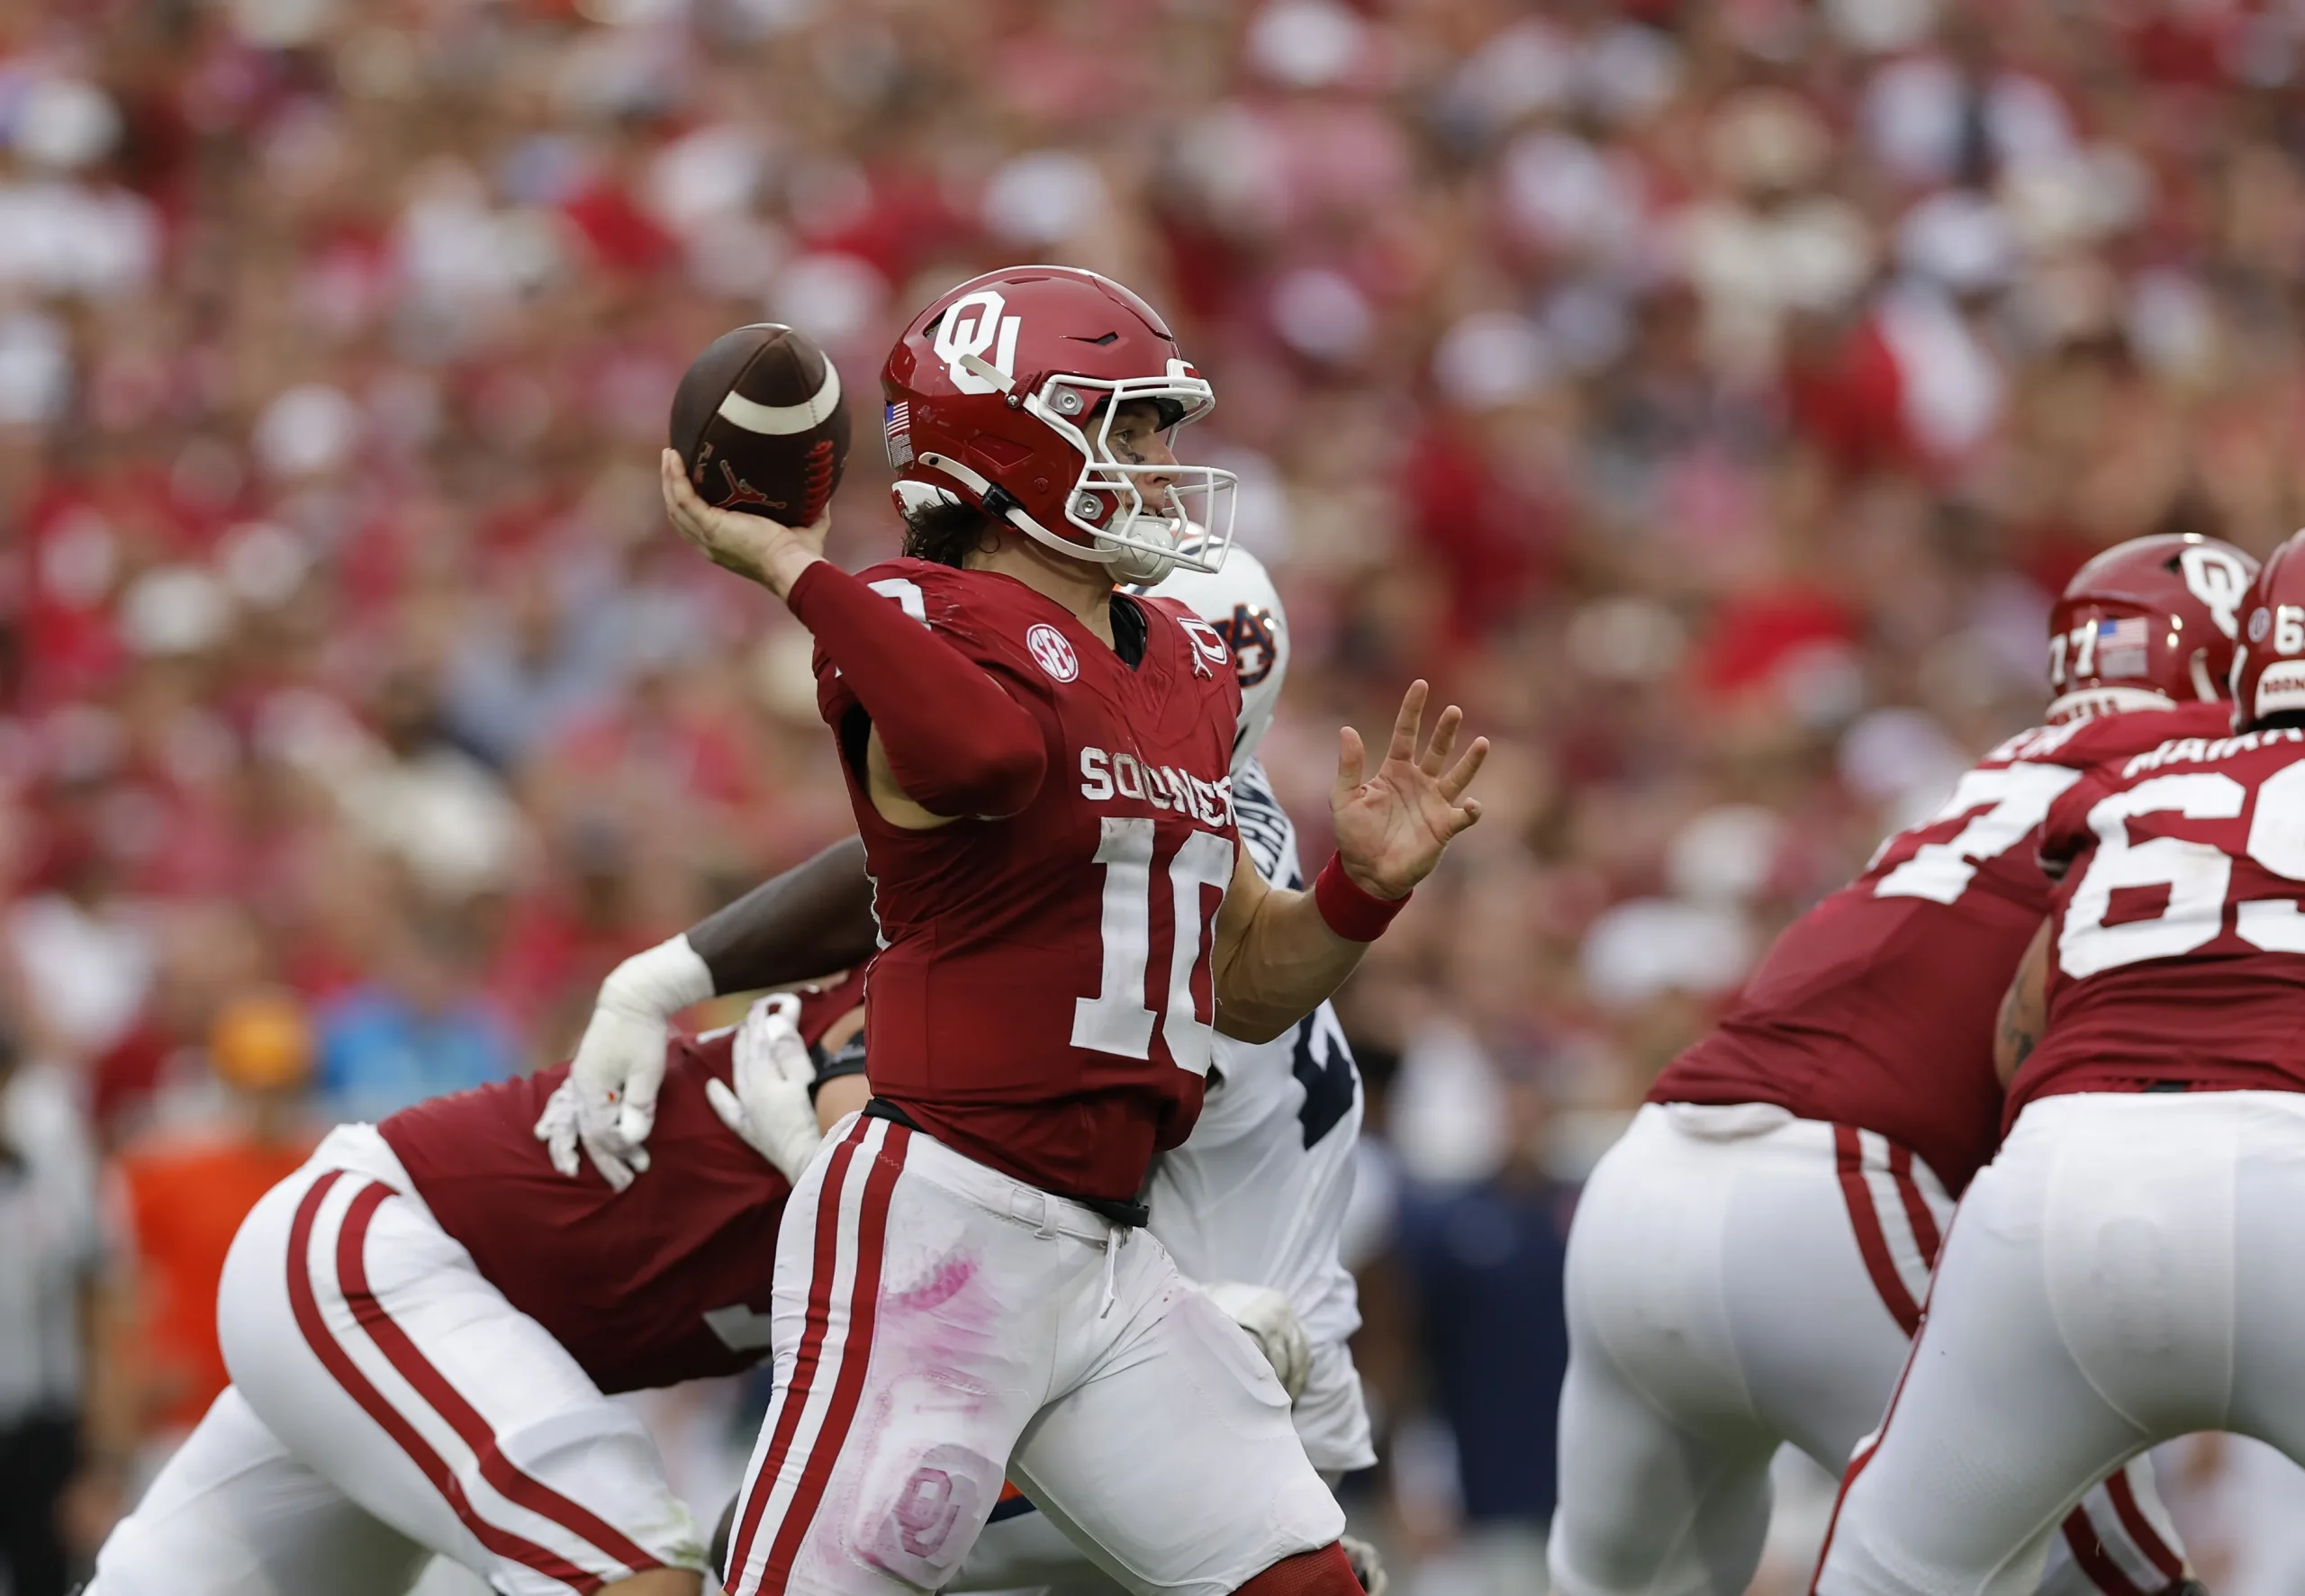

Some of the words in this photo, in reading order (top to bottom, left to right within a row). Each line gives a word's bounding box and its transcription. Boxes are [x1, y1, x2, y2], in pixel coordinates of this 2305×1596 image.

[1031, 628, 1075, 680] SEC
[2273, 605, 2305, 655] 6
[1867, 761, 2084, 905] 7
[1070, 816, 1234, 1078] 10
